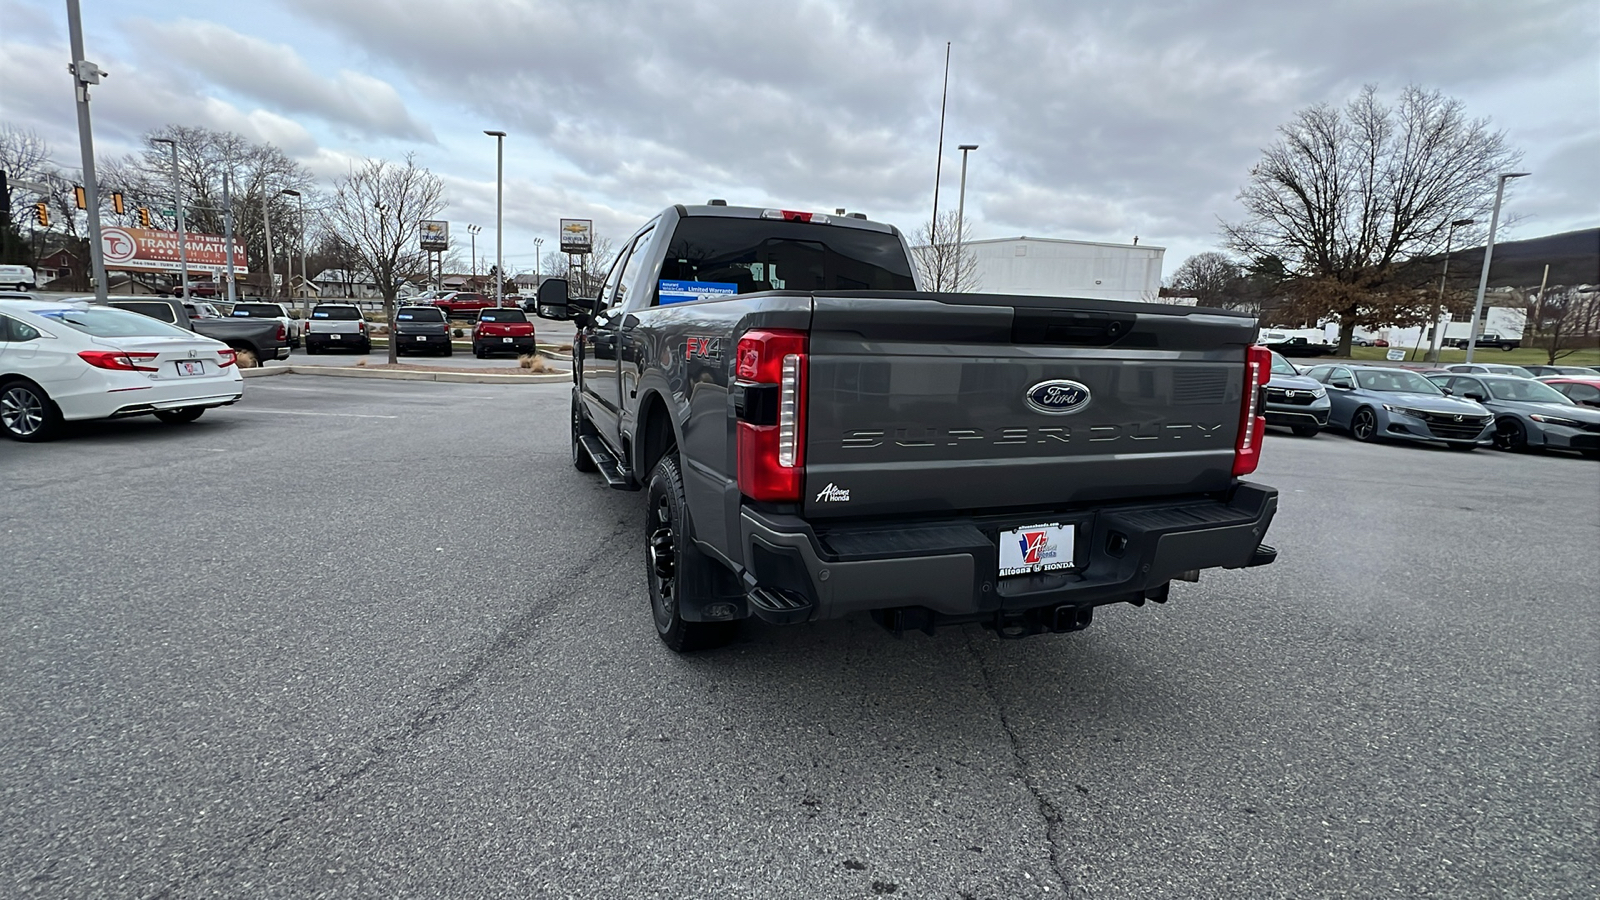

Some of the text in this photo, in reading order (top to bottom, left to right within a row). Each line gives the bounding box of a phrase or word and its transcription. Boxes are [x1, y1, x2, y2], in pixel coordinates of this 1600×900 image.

[685, 337, 721, 361] FX4
[1043, 386, 1078, 404] Ford
[842, 423, 1222, 448] SUPER DUTY
[999, 562, 1075, 577] Altoona HONDA
